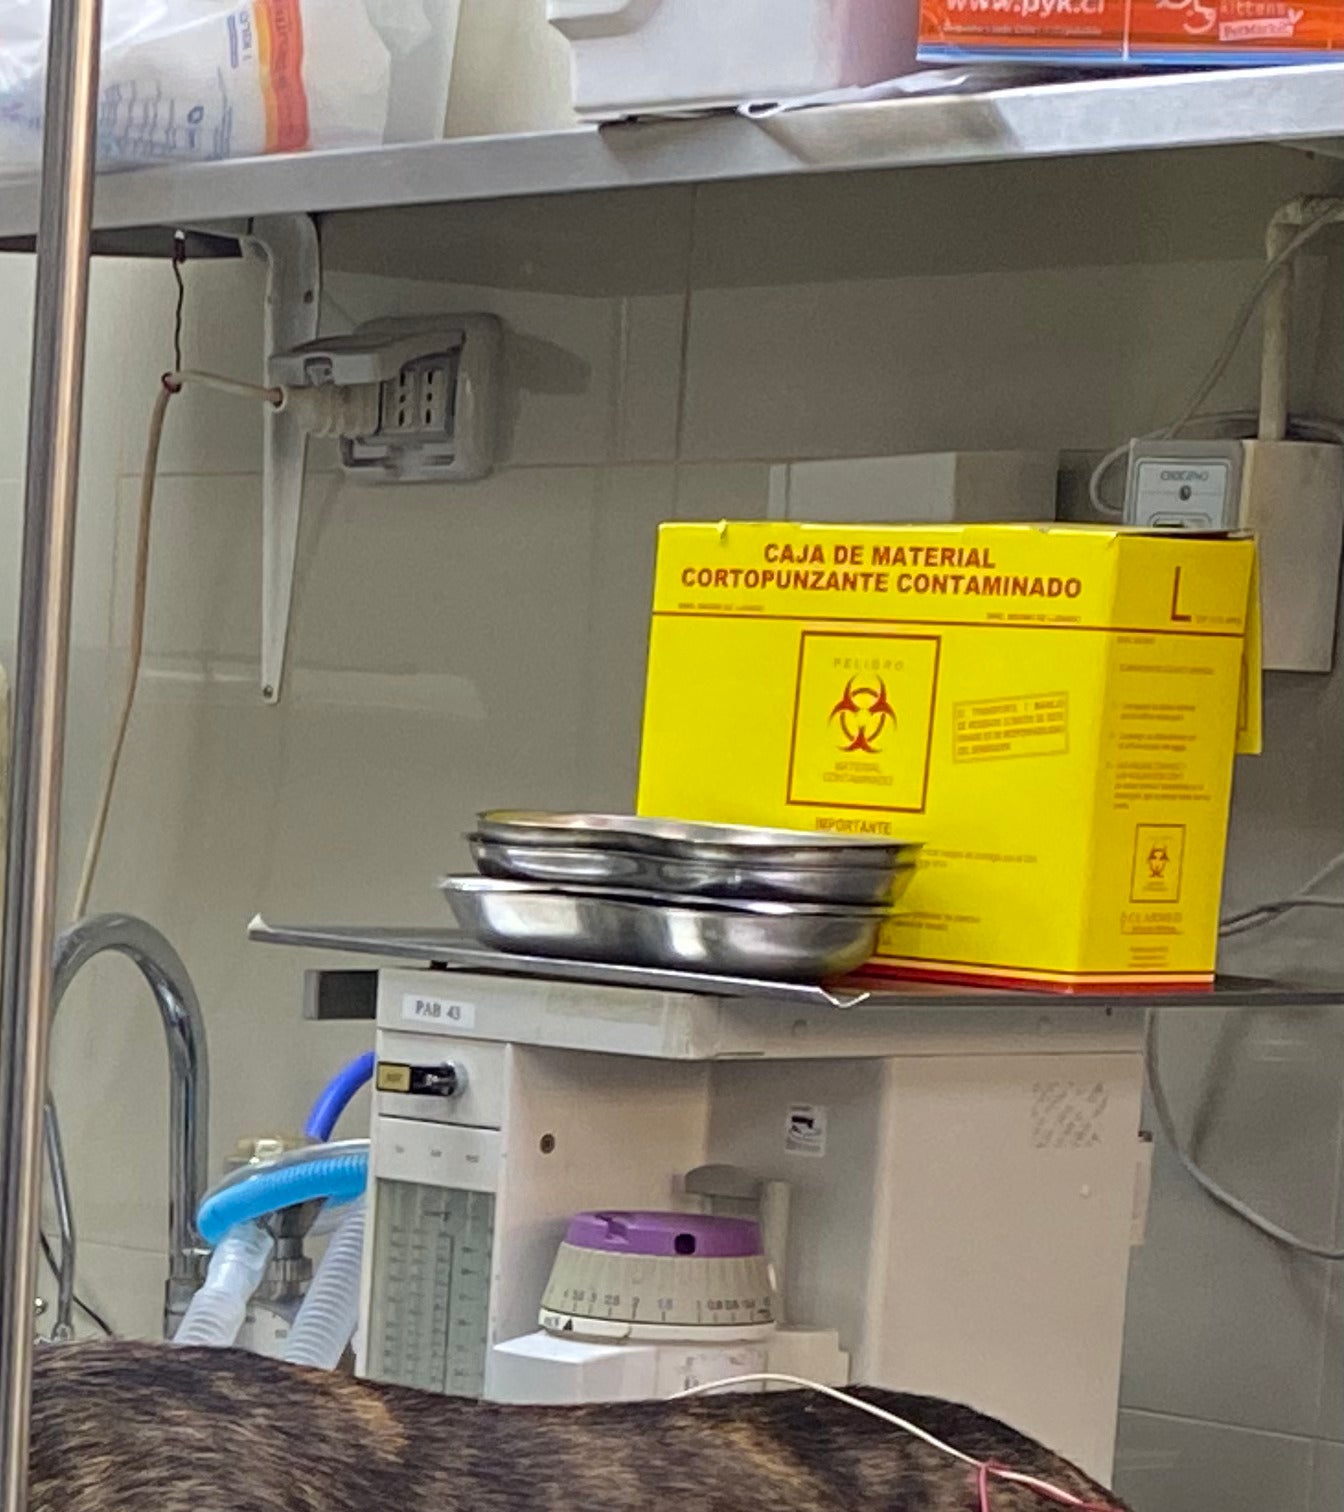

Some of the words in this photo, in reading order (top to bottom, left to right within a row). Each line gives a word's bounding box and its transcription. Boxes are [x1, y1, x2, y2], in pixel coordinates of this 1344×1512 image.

[764, 543, 825, 564] CAJA
[834, 545, 864, 566] DE
[871, 546, 996, 568] MATERIAL
[681, 568, 889, 593] CORTOPUNZANTE
[896, 573, 1082, 598] CONTAMINADO
[1171, 566, 1192, 622] L
